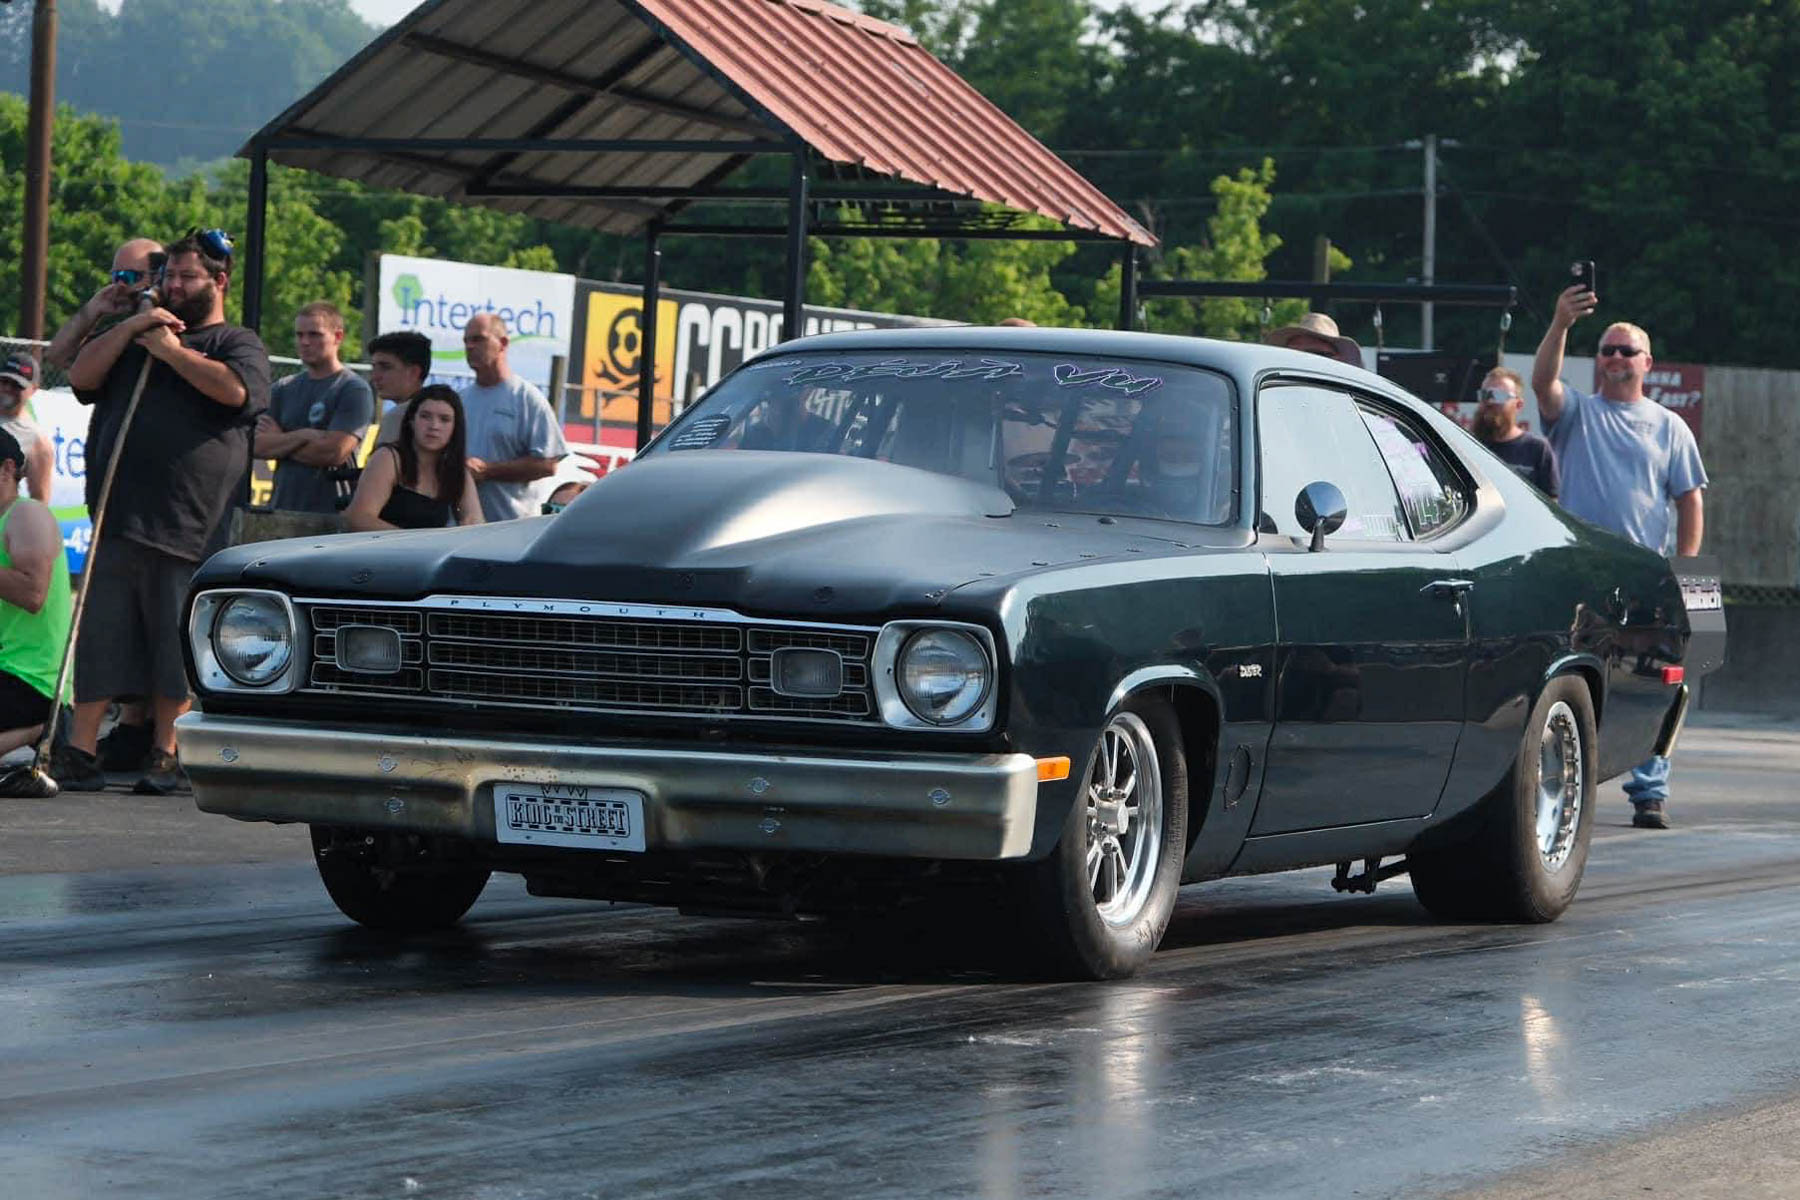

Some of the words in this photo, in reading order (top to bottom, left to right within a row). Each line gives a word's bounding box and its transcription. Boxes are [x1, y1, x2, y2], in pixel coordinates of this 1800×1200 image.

[450, 601, 705, 618] PLYMOUTH
[512, 803, 552, 825] KING
[565, 807, 625, 830] STREET
